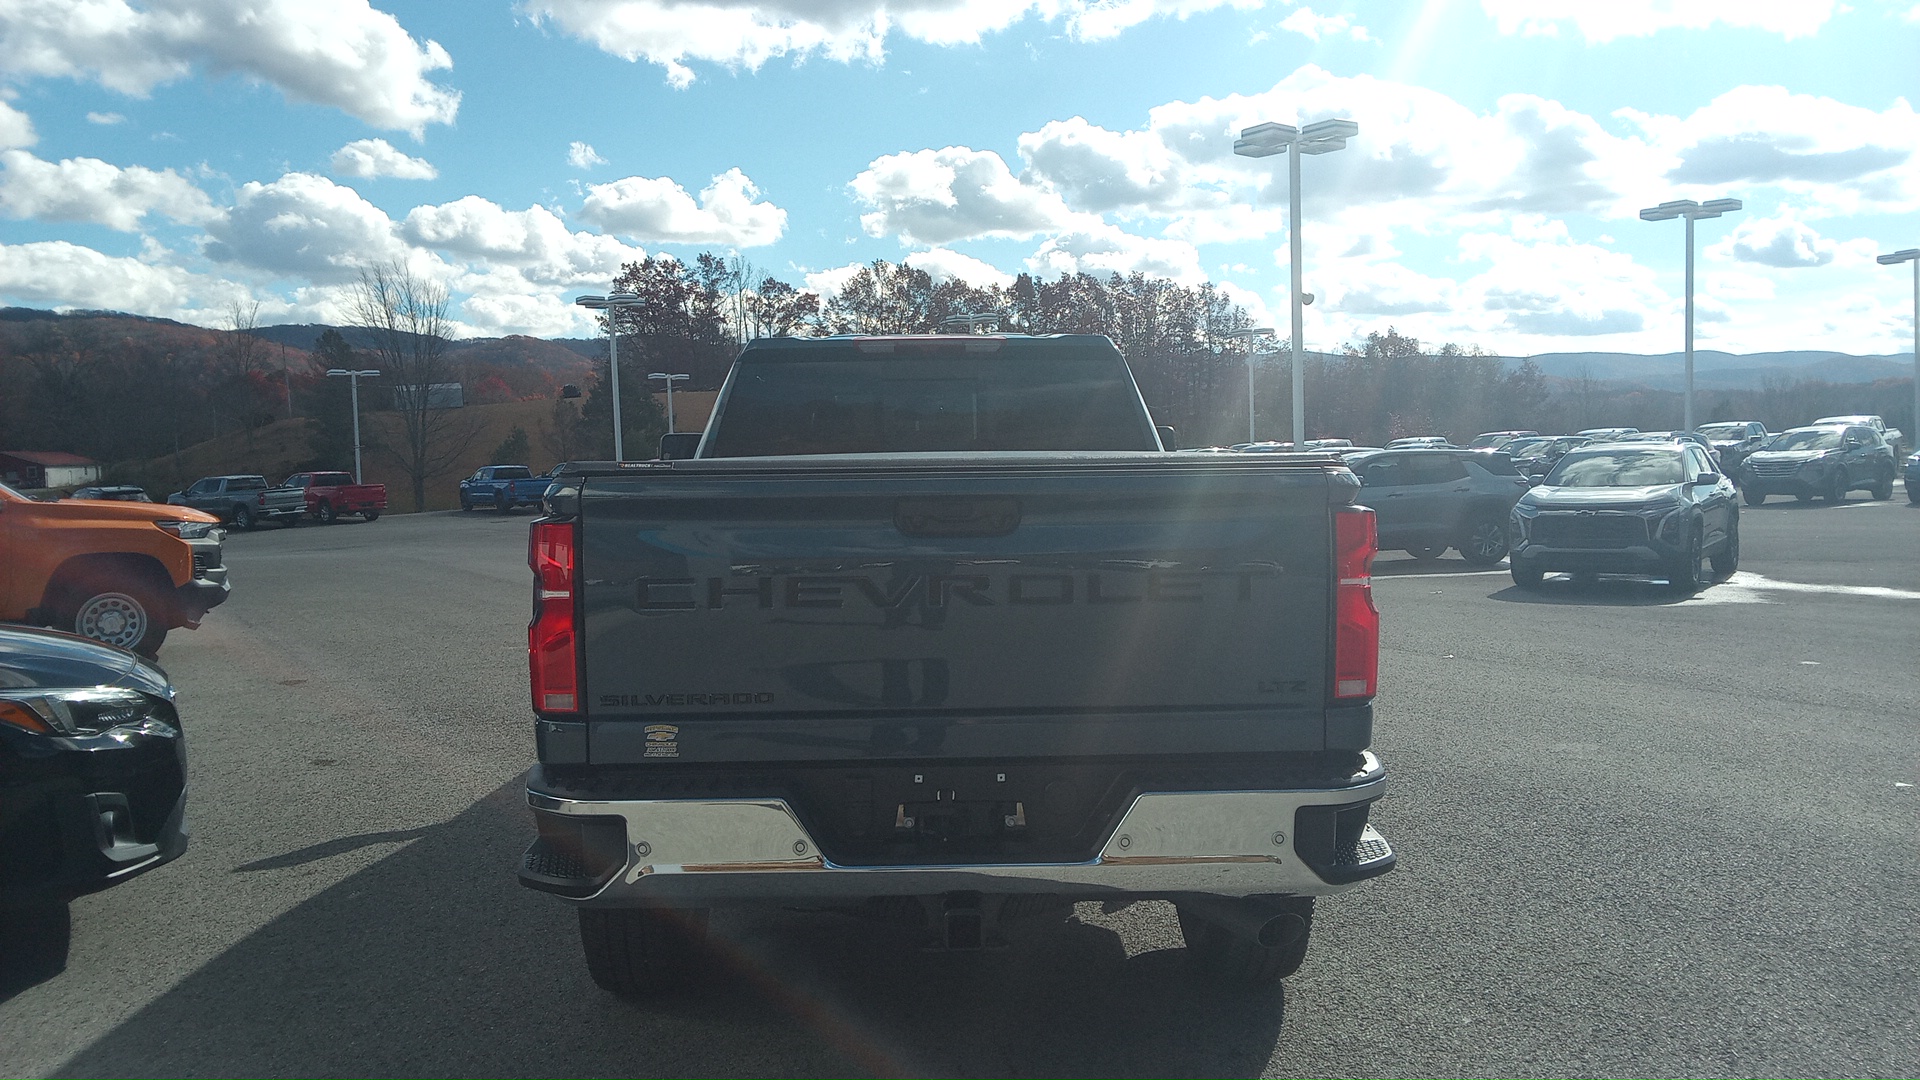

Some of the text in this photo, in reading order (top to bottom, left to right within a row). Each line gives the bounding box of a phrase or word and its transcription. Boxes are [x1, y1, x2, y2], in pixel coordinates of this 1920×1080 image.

[636, 572, 1268, 610] CHEVROLET
[1258, 680, 1307, 693] LTZ
[600, 693, 775, 706] SILVERADO
